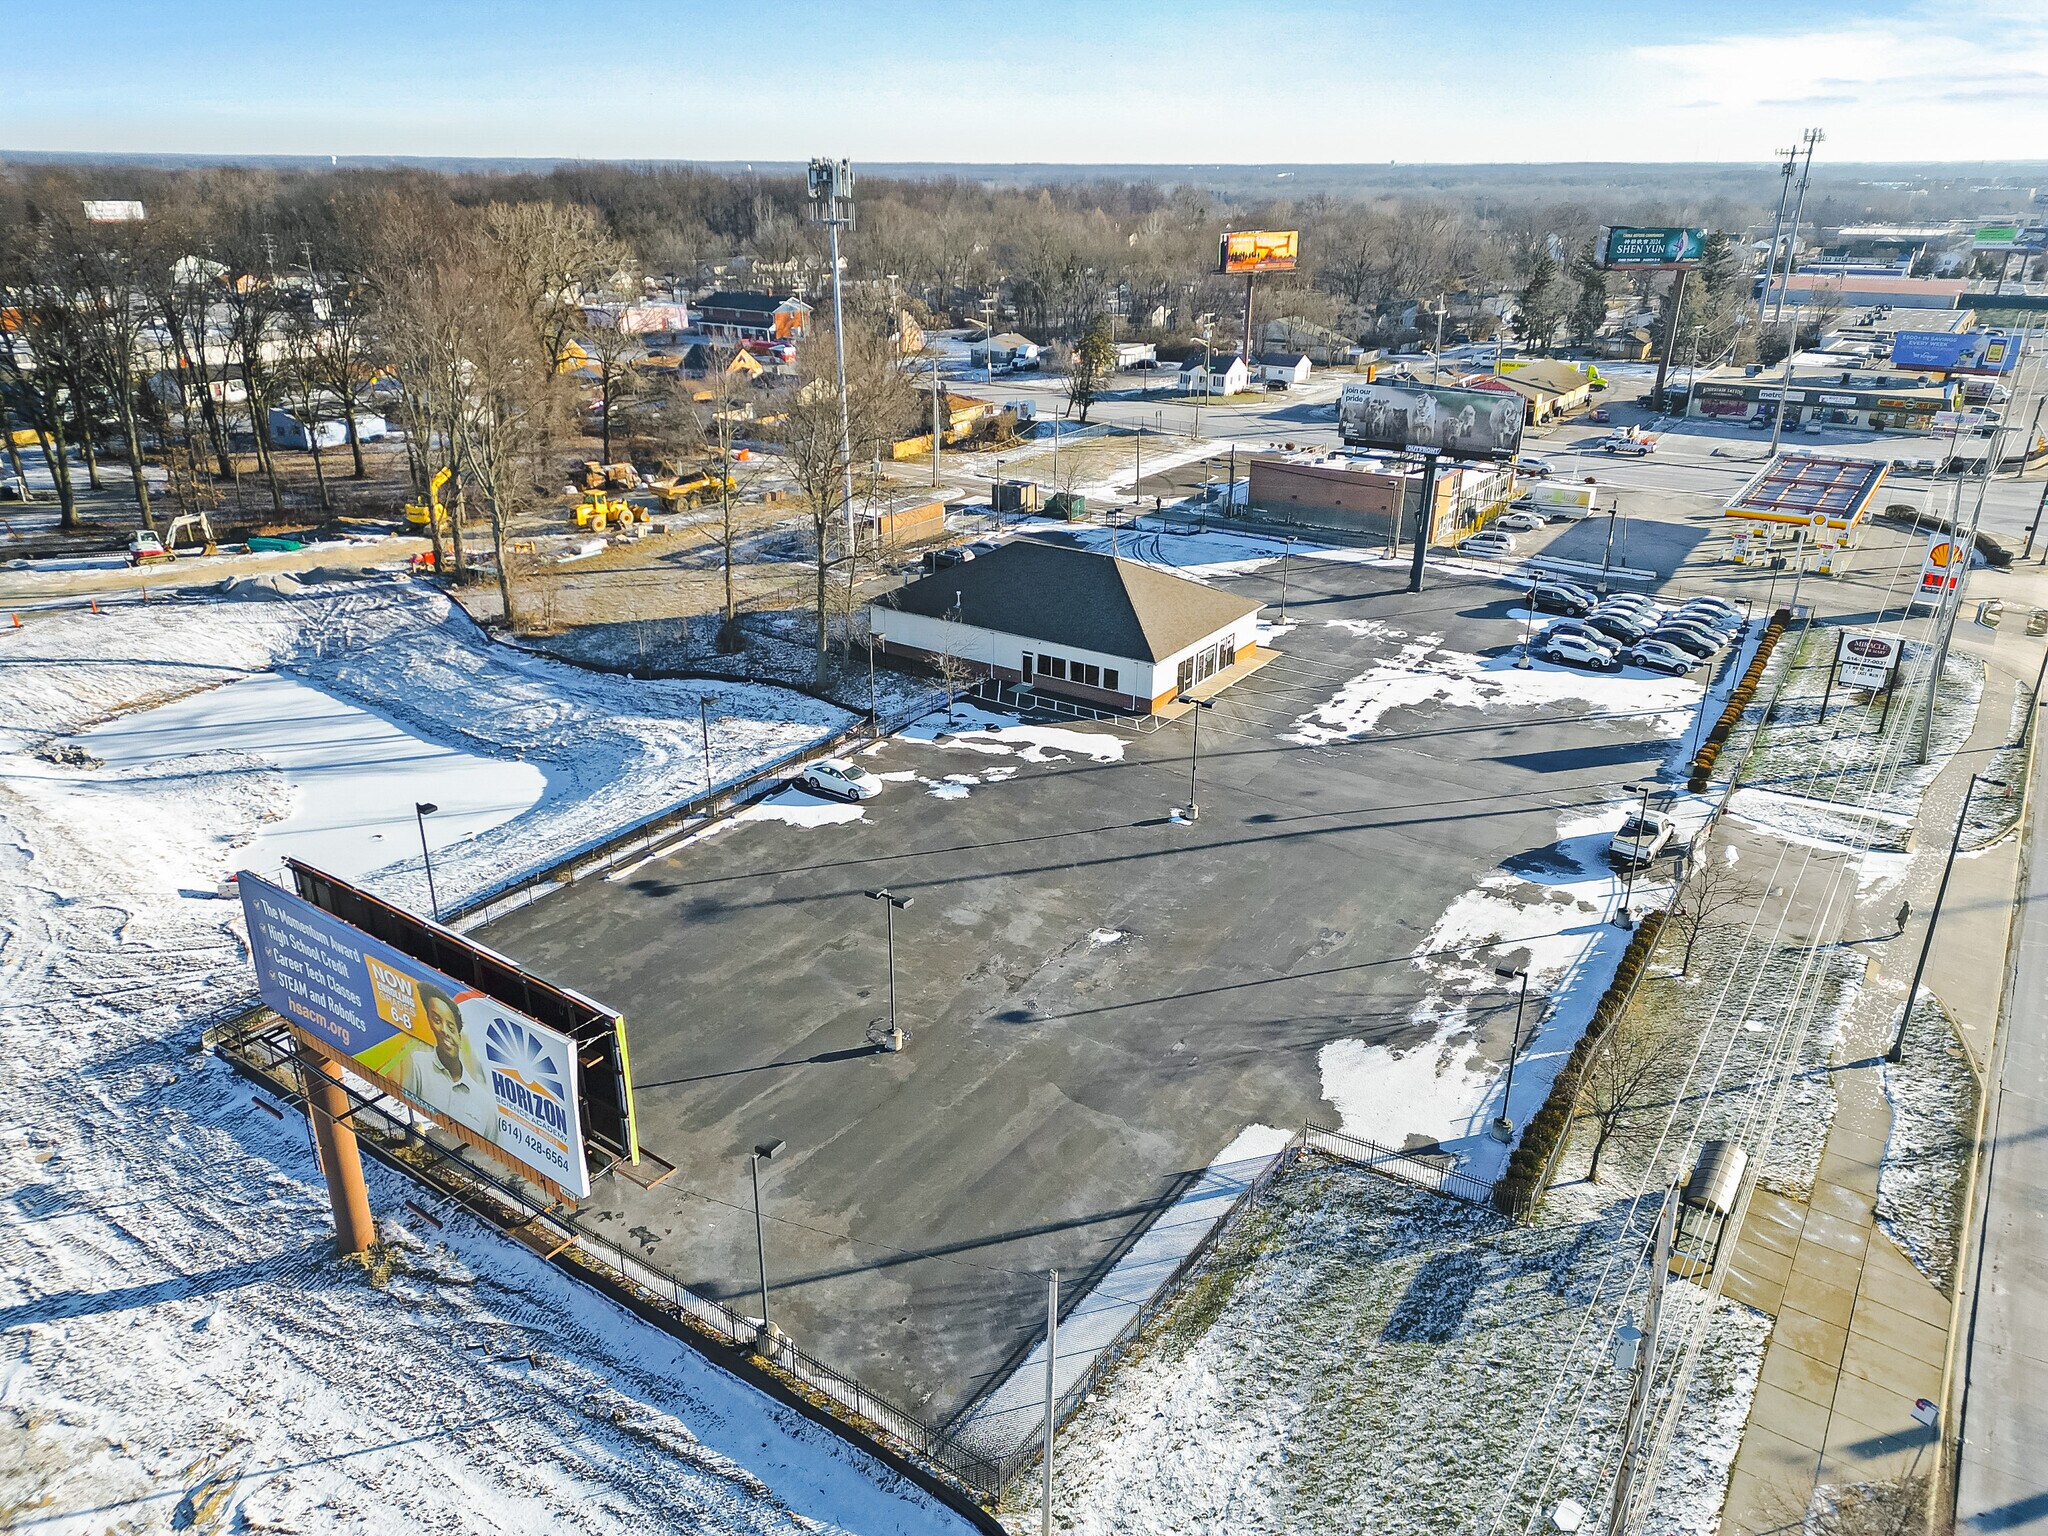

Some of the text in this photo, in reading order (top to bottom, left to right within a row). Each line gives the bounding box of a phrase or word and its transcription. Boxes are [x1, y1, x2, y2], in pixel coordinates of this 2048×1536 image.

[1616, 245, 1665, 254] SHEN YUN
[1920, 352, 1939, 361] Kroger
[1346, 386, 1358, 394] join
[1407, 445, 1440, 454] OUTFRONT
[1854, 641, 1888, 650] MIRACLE
[261, 899, 360, 964] The Momentum Award
[268, 924, 350, 979] High School Credit
[273, 948, 362, 1007] Career Tech Classes
[372, 963, 412, 996] NOW
[377, 981, 415, 1007] ENROLLING
[278, 972, 367, 1032] STEAM and Robotics
[379, 991, 416, 1017] GRADES
[391, 1007, 412, 1029] 6-8
[288, 996, 350, 1046] hsacm.org
[492, 1070, 568, 1135] HORIZON
[495, 1096, 568, 1143] SCIENCE ACADEMY
[498, 1117, 569, 1172] (614) 428-6564
